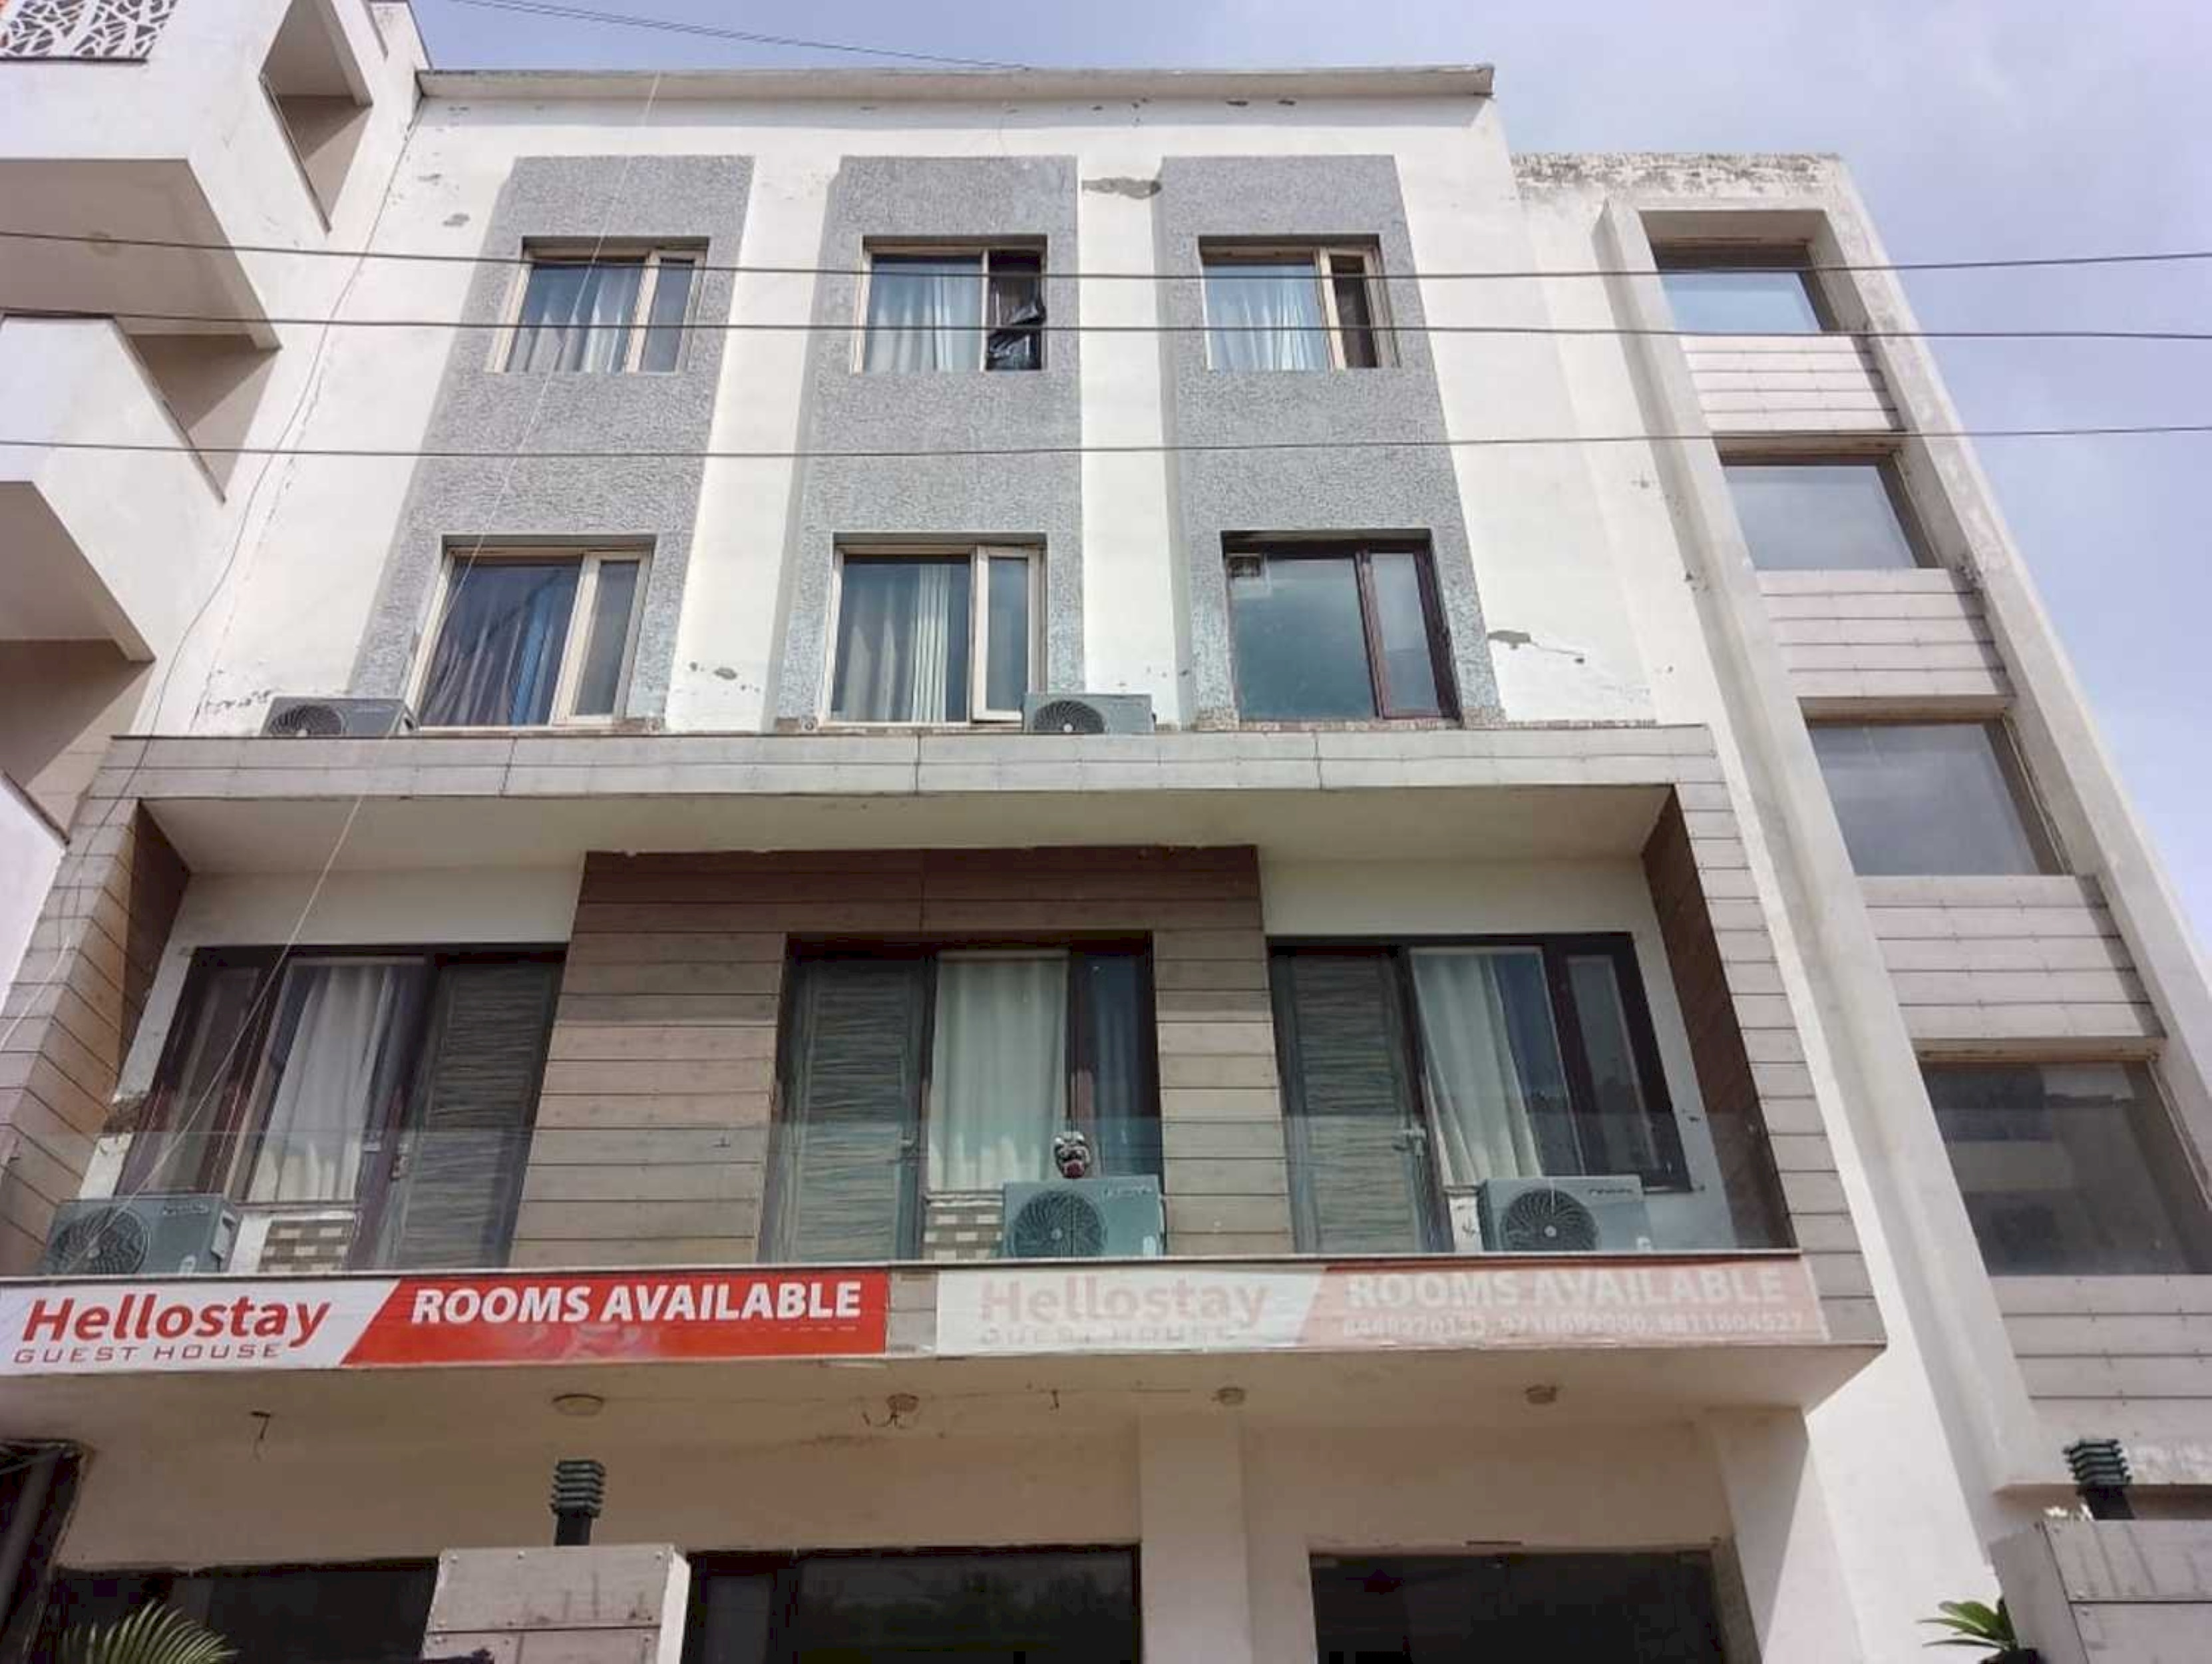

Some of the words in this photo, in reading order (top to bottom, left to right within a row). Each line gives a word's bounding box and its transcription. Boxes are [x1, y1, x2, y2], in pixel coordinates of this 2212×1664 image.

[411, 1286, 592, 1325] ROOMS
[600, 1281, 862, 1321] AVAILABLE
[980, 1274, 1270, 1325] Hellostay
[1345, 1272, 1520, 1309] ROOMS
[1533, 1267, 1785, 1307] AVAILABLE
[22, 1293, 331, 1349] Hellostay
[13, 1346, 140, 1364] GUEST
[153, 1343, 285, 1360] HOUSE
